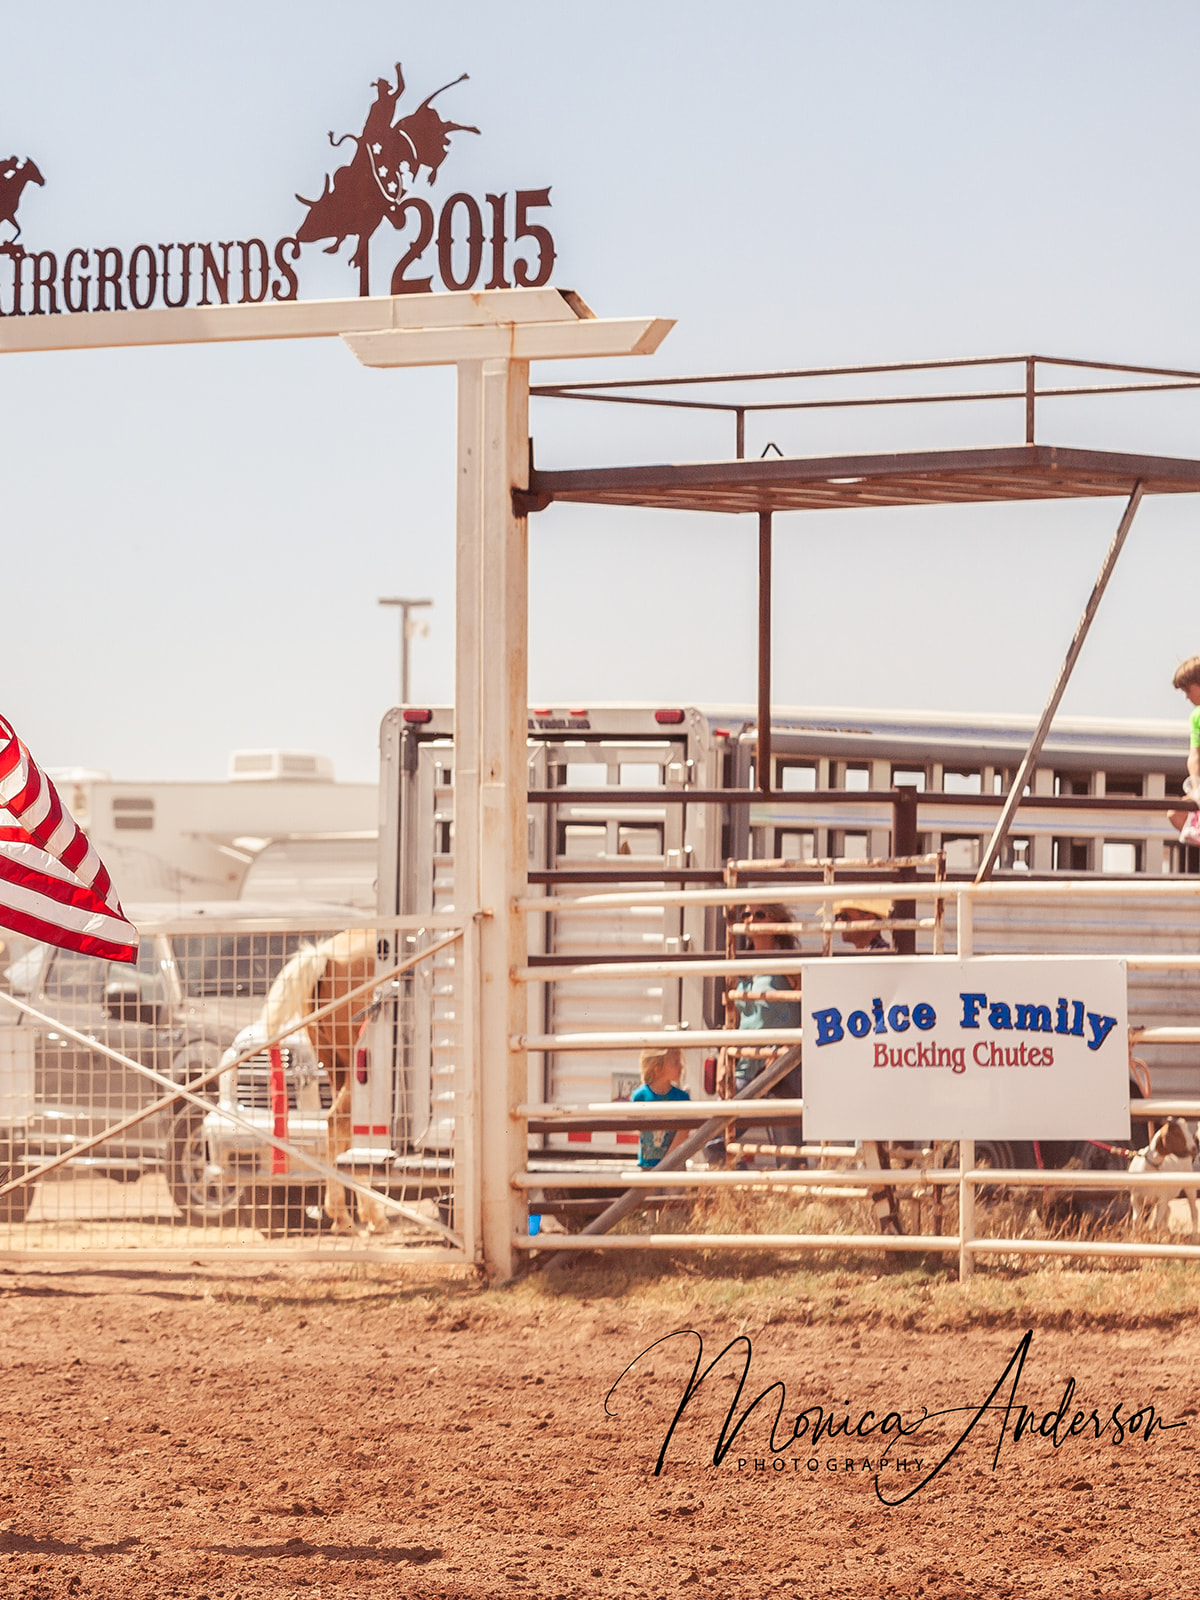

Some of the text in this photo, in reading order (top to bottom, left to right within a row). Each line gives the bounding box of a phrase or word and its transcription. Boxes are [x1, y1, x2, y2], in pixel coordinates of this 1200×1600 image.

[391, 186, 557, 295] 2015
[812, 993, 1117, 1051] Boice Family
[872, 1041, 1054, 1074] Bucking Chutes
